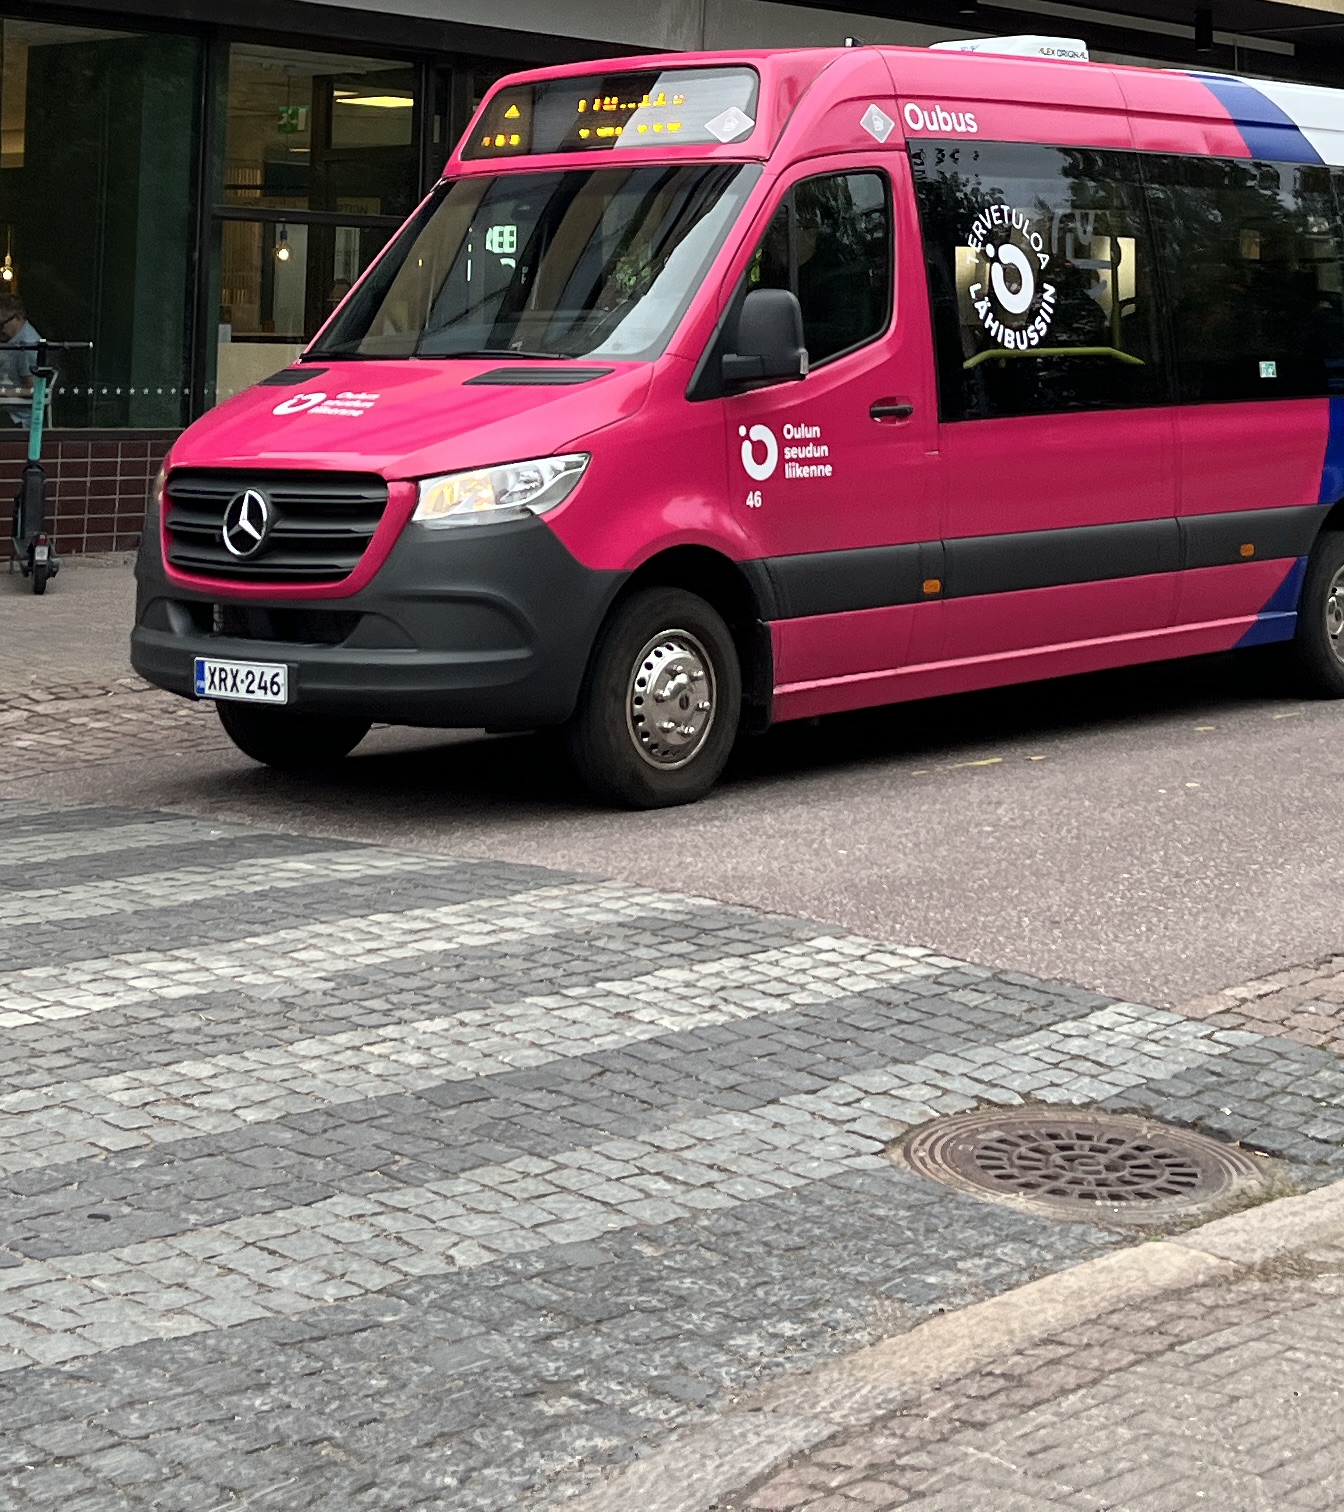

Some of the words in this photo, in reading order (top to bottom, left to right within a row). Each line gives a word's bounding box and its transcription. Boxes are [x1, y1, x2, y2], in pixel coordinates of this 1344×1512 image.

[904, 102, 978, 134] Oubus
[967, 204, 1050, 271] TERVETULOA
[969, 283, 1057, 351] LÄHIBUSSIIN
[783, 423, 821, 440] Oulun
[784, 442, 829, 460] seudun
[784, 461, 833, 479] liikenne
[745, 490, 763, 508] 46
[208, 665, 281, 697] XRX-246
